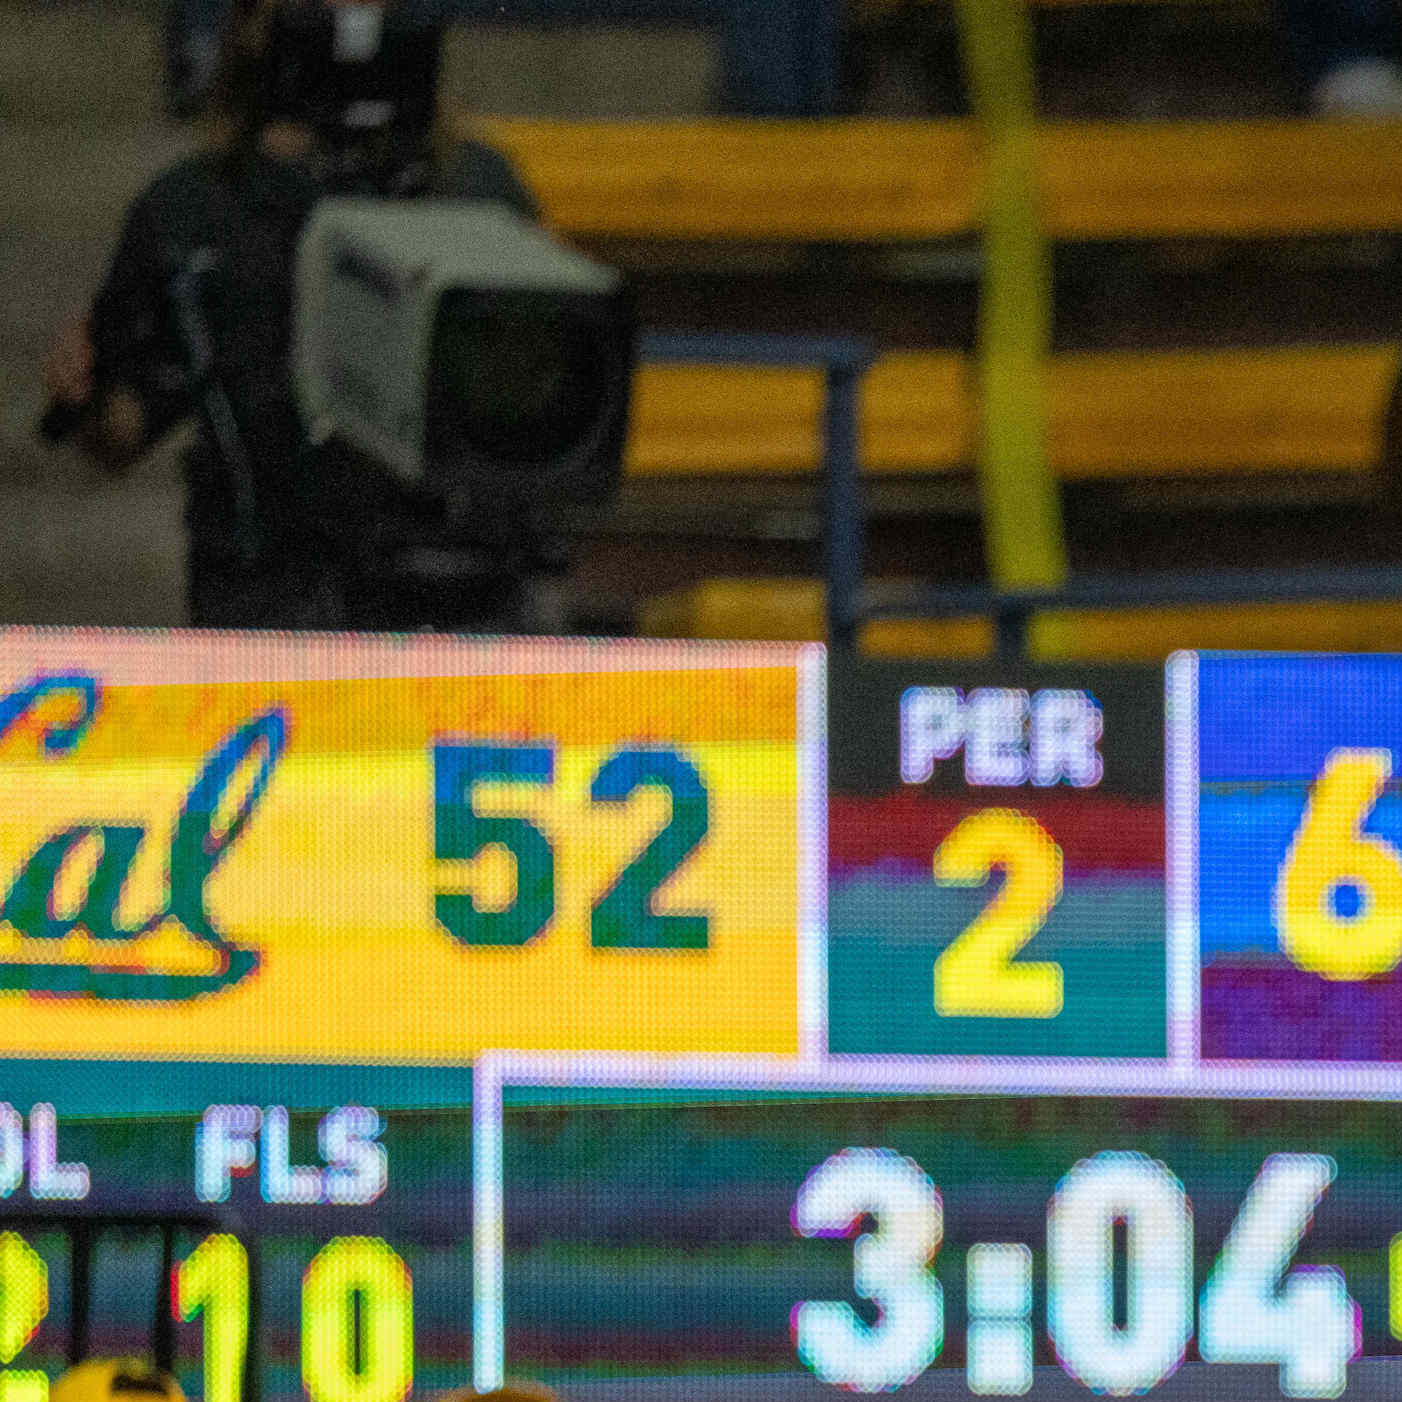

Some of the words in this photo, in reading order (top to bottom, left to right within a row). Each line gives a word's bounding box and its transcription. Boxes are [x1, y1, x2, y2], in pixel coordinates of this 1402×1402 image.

[899, 686, 1104, 788] PER
[431, 736, 715, 952] 52
[933, 808, 1064, 1018] 2
[195, 1104, 388, 1202] FLS
[790, 1146, 1363, 1398] 3:04
